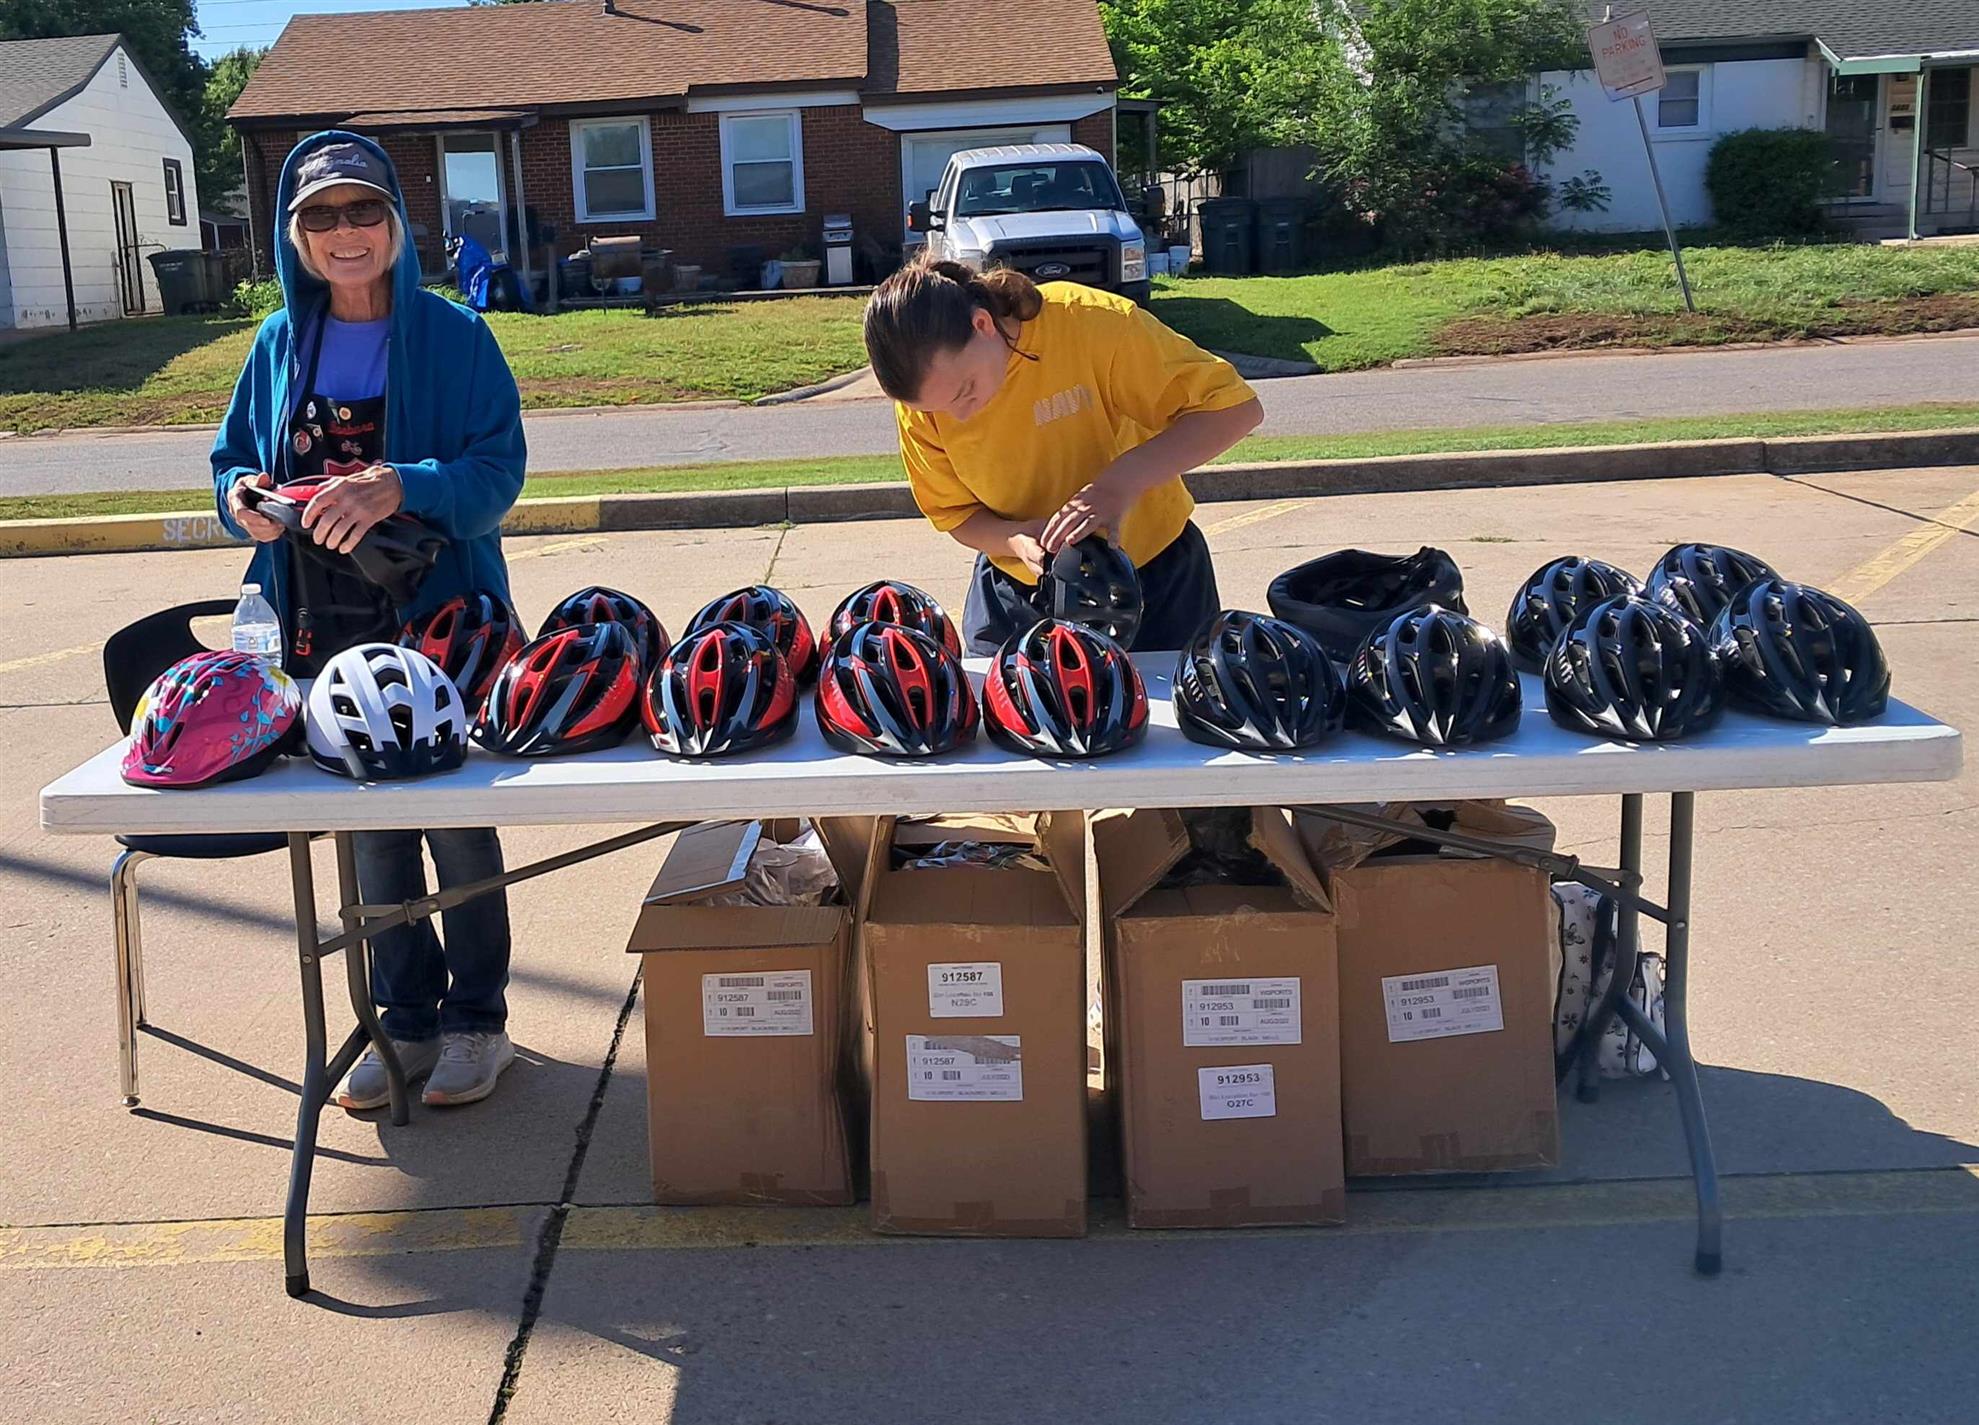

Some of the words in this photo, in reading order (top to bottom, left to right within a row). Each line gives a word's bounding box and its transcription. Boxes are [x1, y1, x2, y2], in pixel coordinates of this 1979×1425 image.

[1613, 26, 1628, 40] NO
[1602, 37, 1646, 56] PARKING
[942, 972, 983, 982] 912587
[718, 994, 749, 1002] 912587
[1401, 995, 1434, 1006] 912953
[1200, 1002, 1234, 1011] 912953
[1201, 1016, 1210, 1026] 10
[1403, 1011, 1413, 1021] 10
[922, 1057, 955, 1065] 912587
[924, 1071, 933, 1080] 10
[1217, 1073, 1260, 1084] 912953
